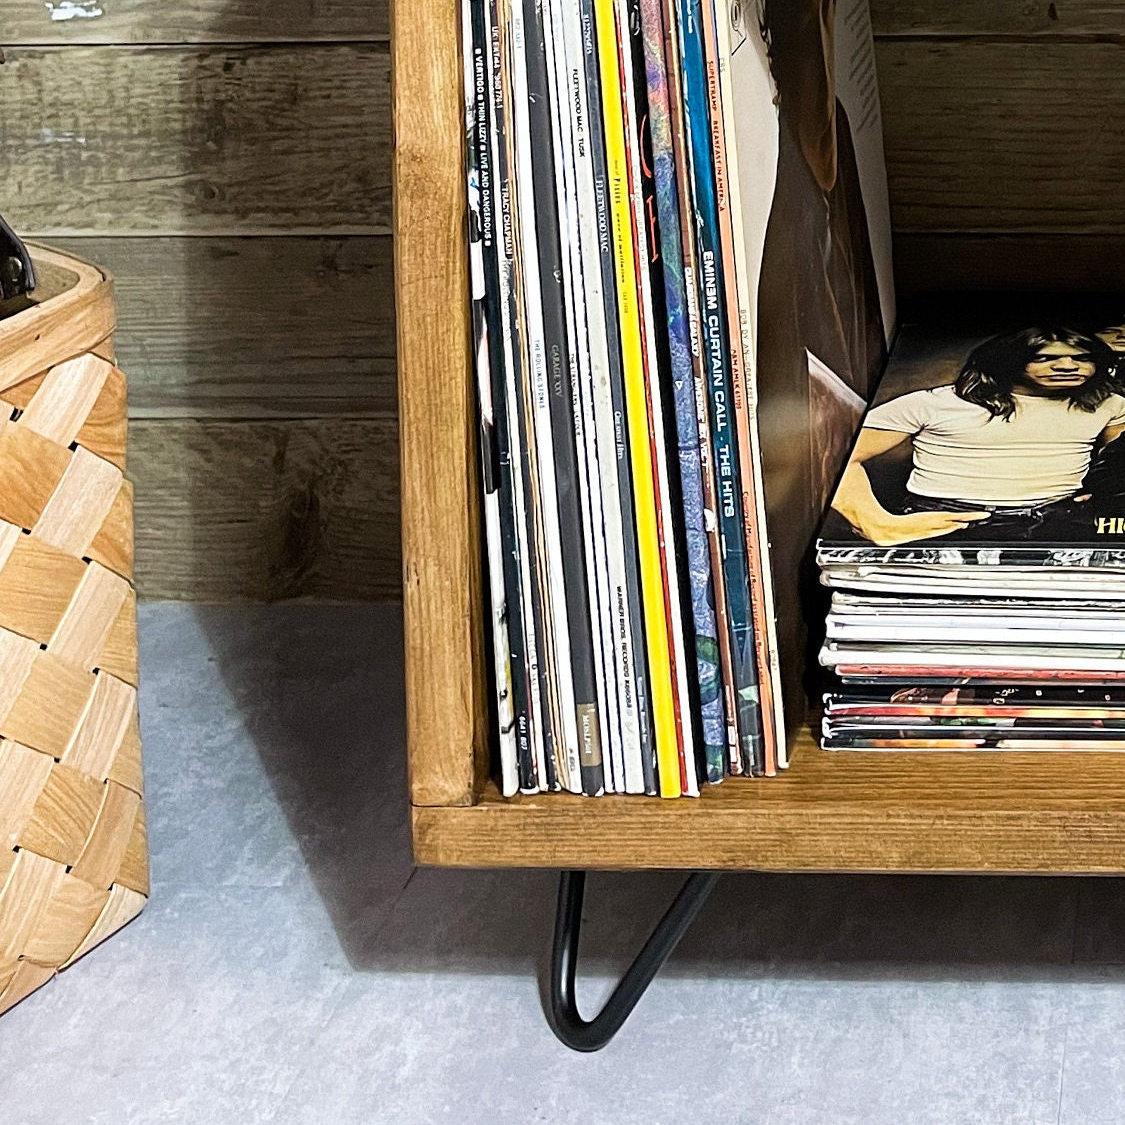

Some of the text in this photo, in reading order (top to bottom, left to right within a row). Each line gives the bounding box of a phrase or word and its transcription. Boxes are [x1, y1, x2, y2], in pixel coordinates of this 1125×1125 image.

[572, 68, 582, 115] FLEETWOOD
[475, 55, 492, 240] VERTIGO THIN LIZZY LIVE AND DANGEROUS
[707, 60, 725, 212] SUPERTRAMP BREAKFAST IN AMERIA
[501, 187, 509, 213] TRACY
[595, 180, 607, 231] FLEETWOOD
[503, 214, 513, 255] CHAPMAN
[599, 232, 609, 253] MAC
[535, 353, 543, 382] ROLLING
[551, 344, 561, 380] GARAGE
[708, 315, 724, 386] CURTAIN
[537, 383, 546, 409] STONES
[714, 390, 727, 432] CALL
[719, 444, 731, 477] THE
[722, 480, 735, 518] HITS
[616, 585, 624, 617] WARNER
[621, 642, 629, 678] RECORDS
[519, 715, 528, 751] 6641 807
